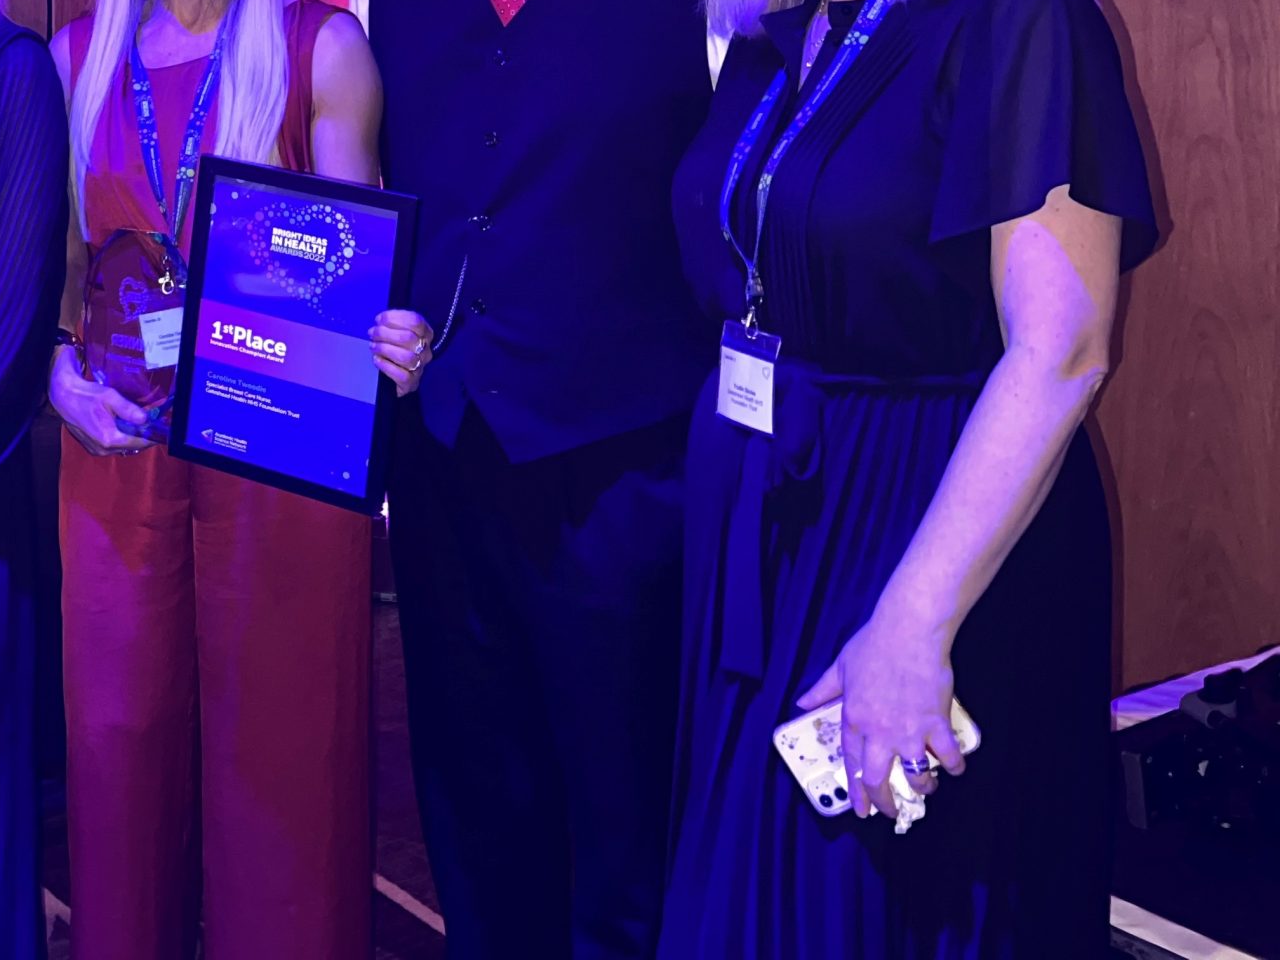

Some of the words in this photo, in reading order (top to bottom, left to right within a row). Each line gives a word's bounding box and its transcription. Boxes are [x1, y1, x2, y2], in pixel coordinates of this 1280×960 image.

[271, 235, 283, 246] IN
[284, 237, 327, 256] HEALTH
[273, 227, 302, 241] BRIGHT
[303, 234, 328, 247] IDEAS
[210, 339, 238, 351] Innovation
[239, 346, 267, 358] Champion
[266, 353, 285, 364] Award
